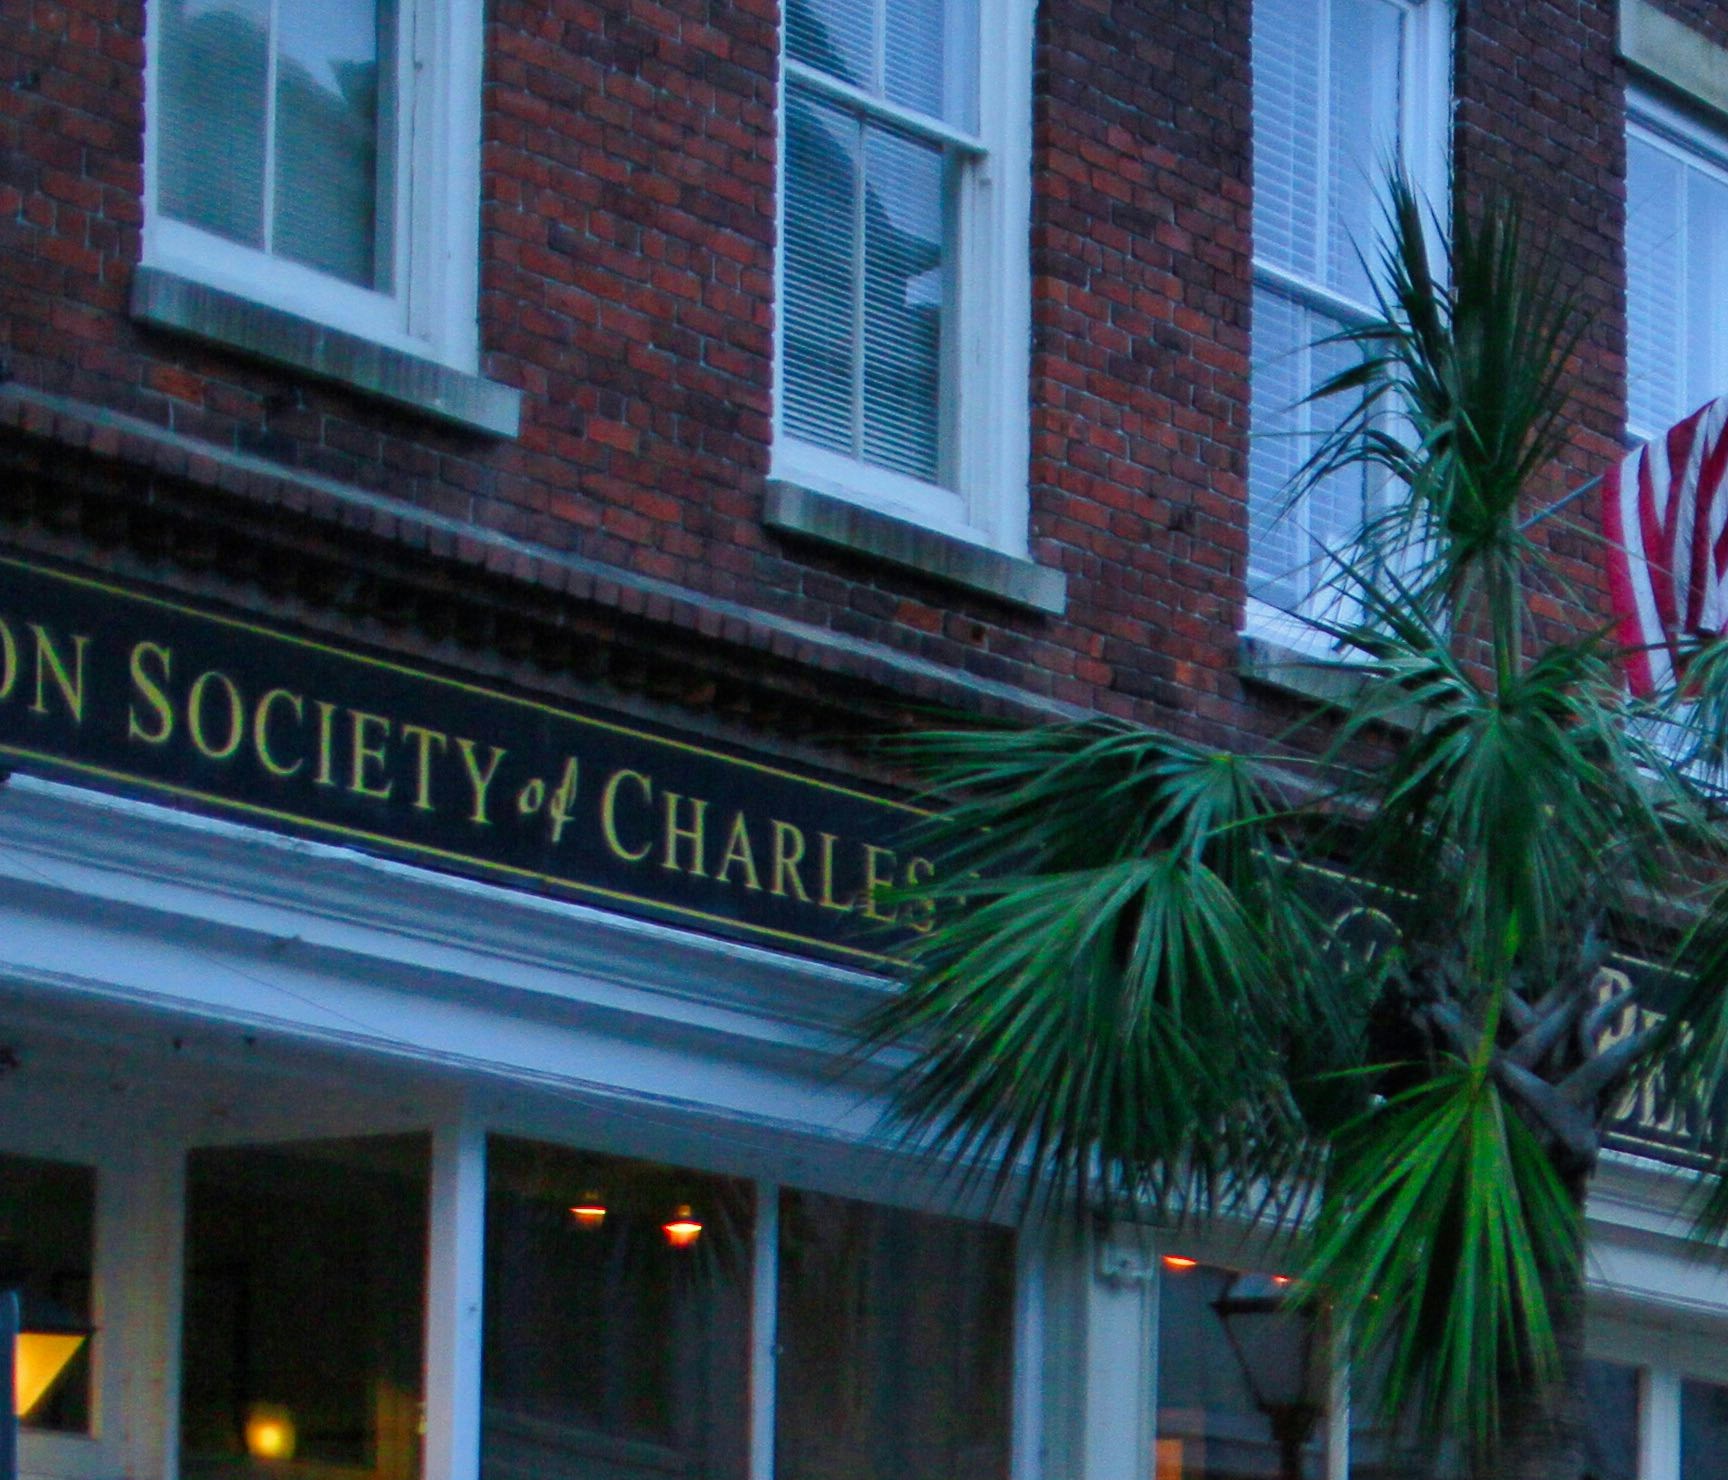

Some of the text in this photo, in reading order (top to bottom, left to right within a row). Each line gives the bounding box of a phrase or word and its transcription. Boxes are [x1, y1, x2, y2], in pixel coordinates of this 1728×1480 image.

[0, 617, 983, 934] N SOCIETY of CHARLES
